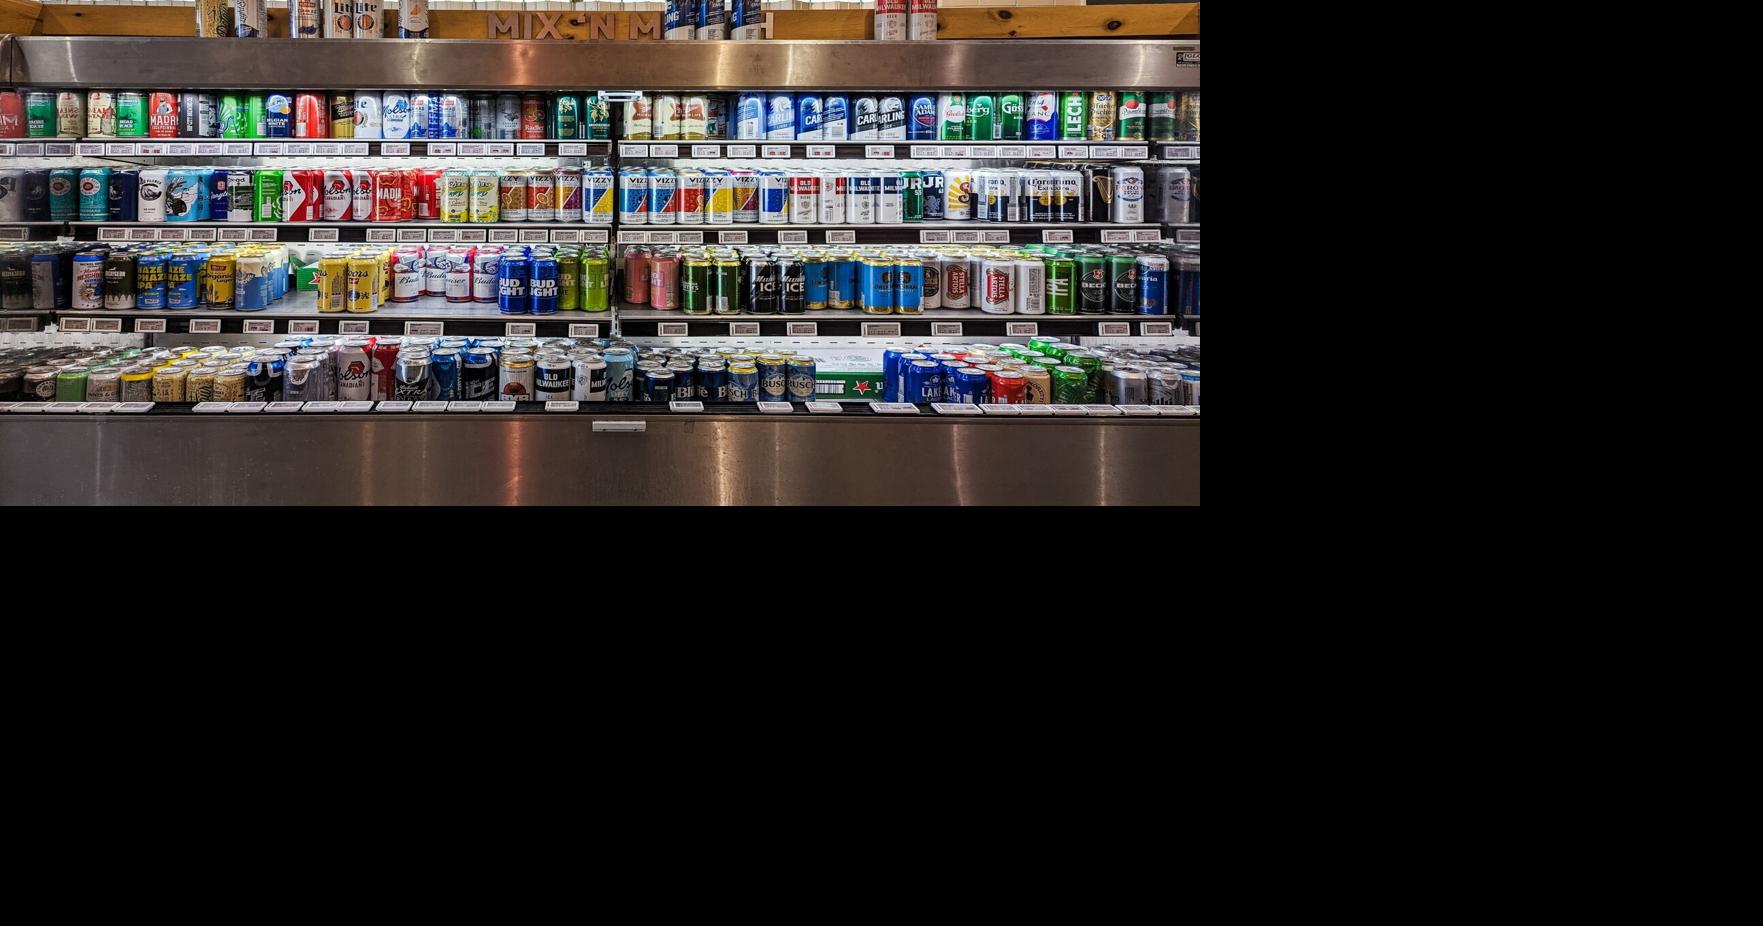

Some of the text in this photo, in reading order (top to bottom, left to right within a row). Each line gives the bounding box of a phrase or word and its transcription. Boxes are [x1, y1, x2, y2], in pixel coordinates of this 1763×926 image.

[487, 13, 563, 39] MIX
[1066, 97, 1082, 132] LECH
[530, 279, 556, 288] BUD
[786, 282, 805, 292] ICE
